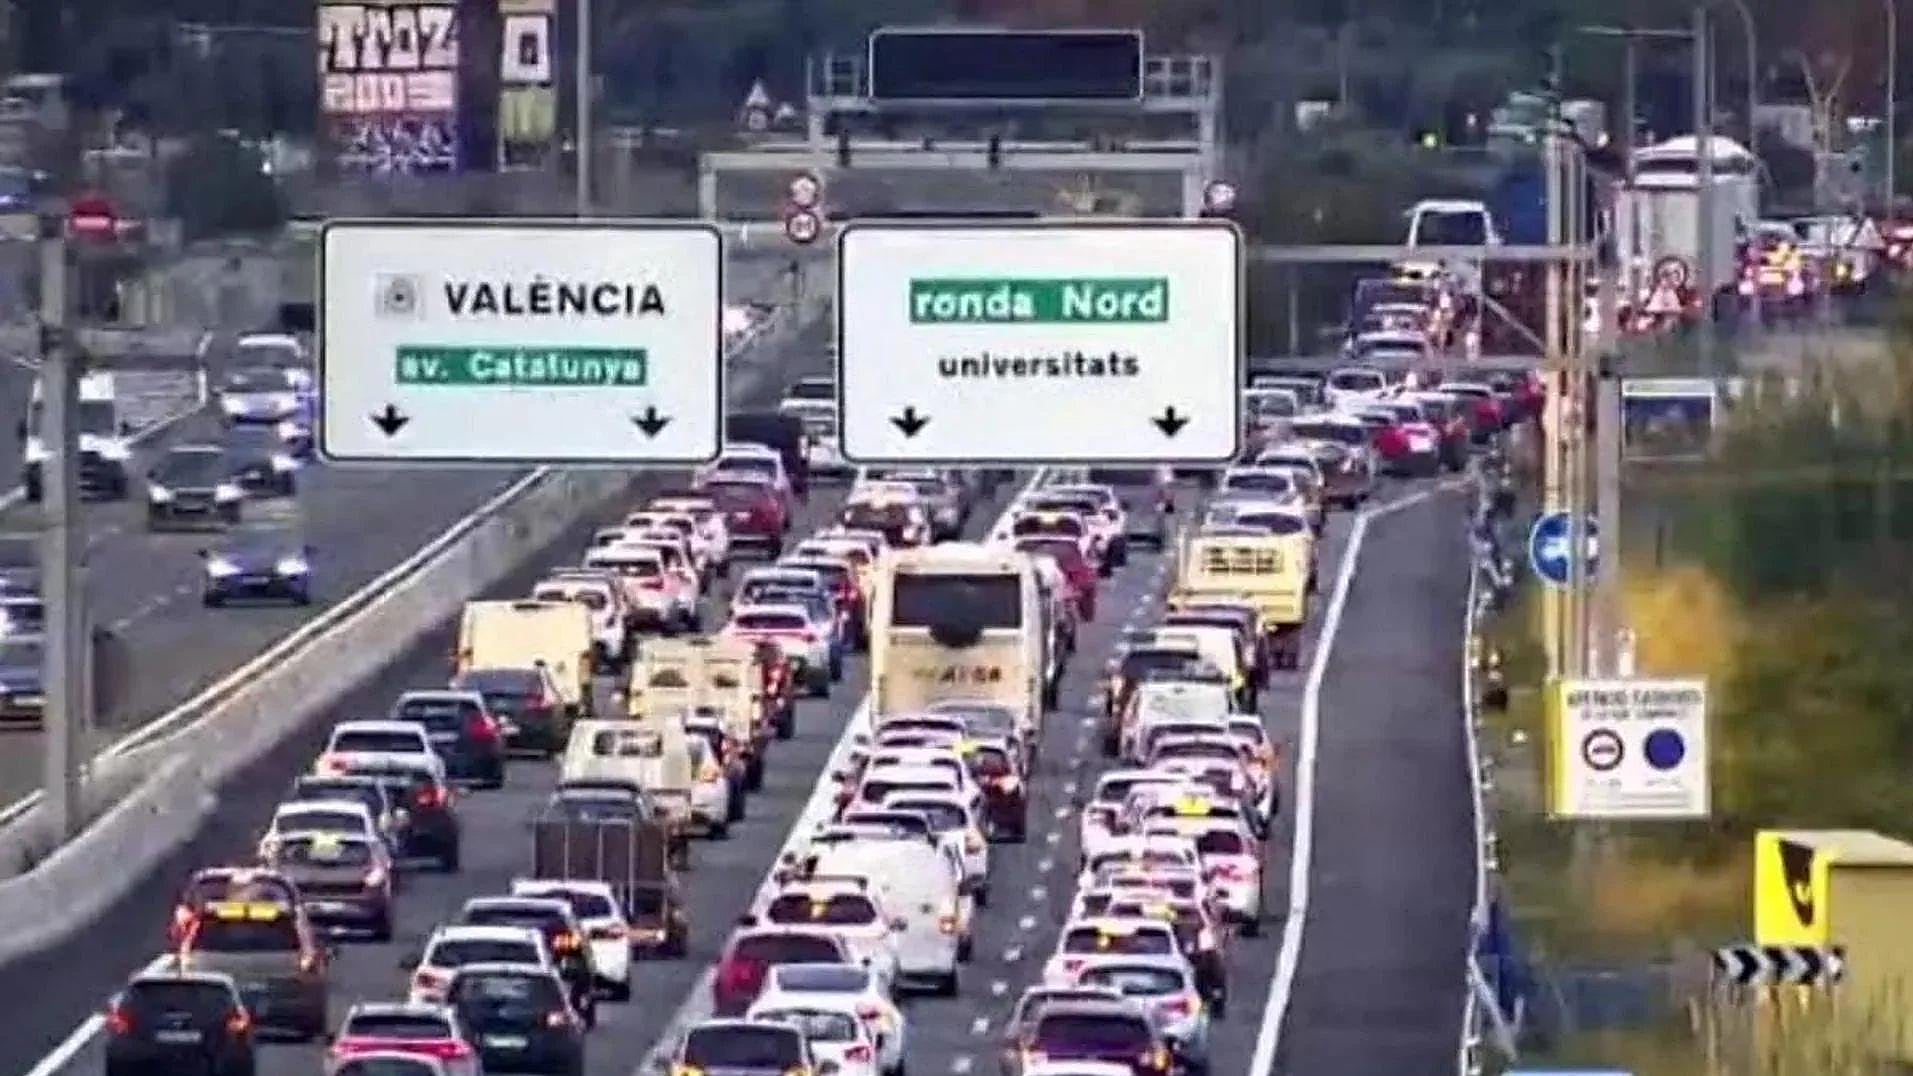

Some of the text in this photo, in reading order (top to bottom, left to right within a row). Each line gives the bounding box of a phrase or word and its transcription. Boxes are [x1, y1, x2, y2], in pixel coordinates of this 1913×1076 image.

[445, 274, 665, 315] VALÈNCIA
[914, 282, 1165, 319] ronda Nord
[400, 350, 643, 384] av. Catalunya
[938, 350, 1140, 378] universitats
